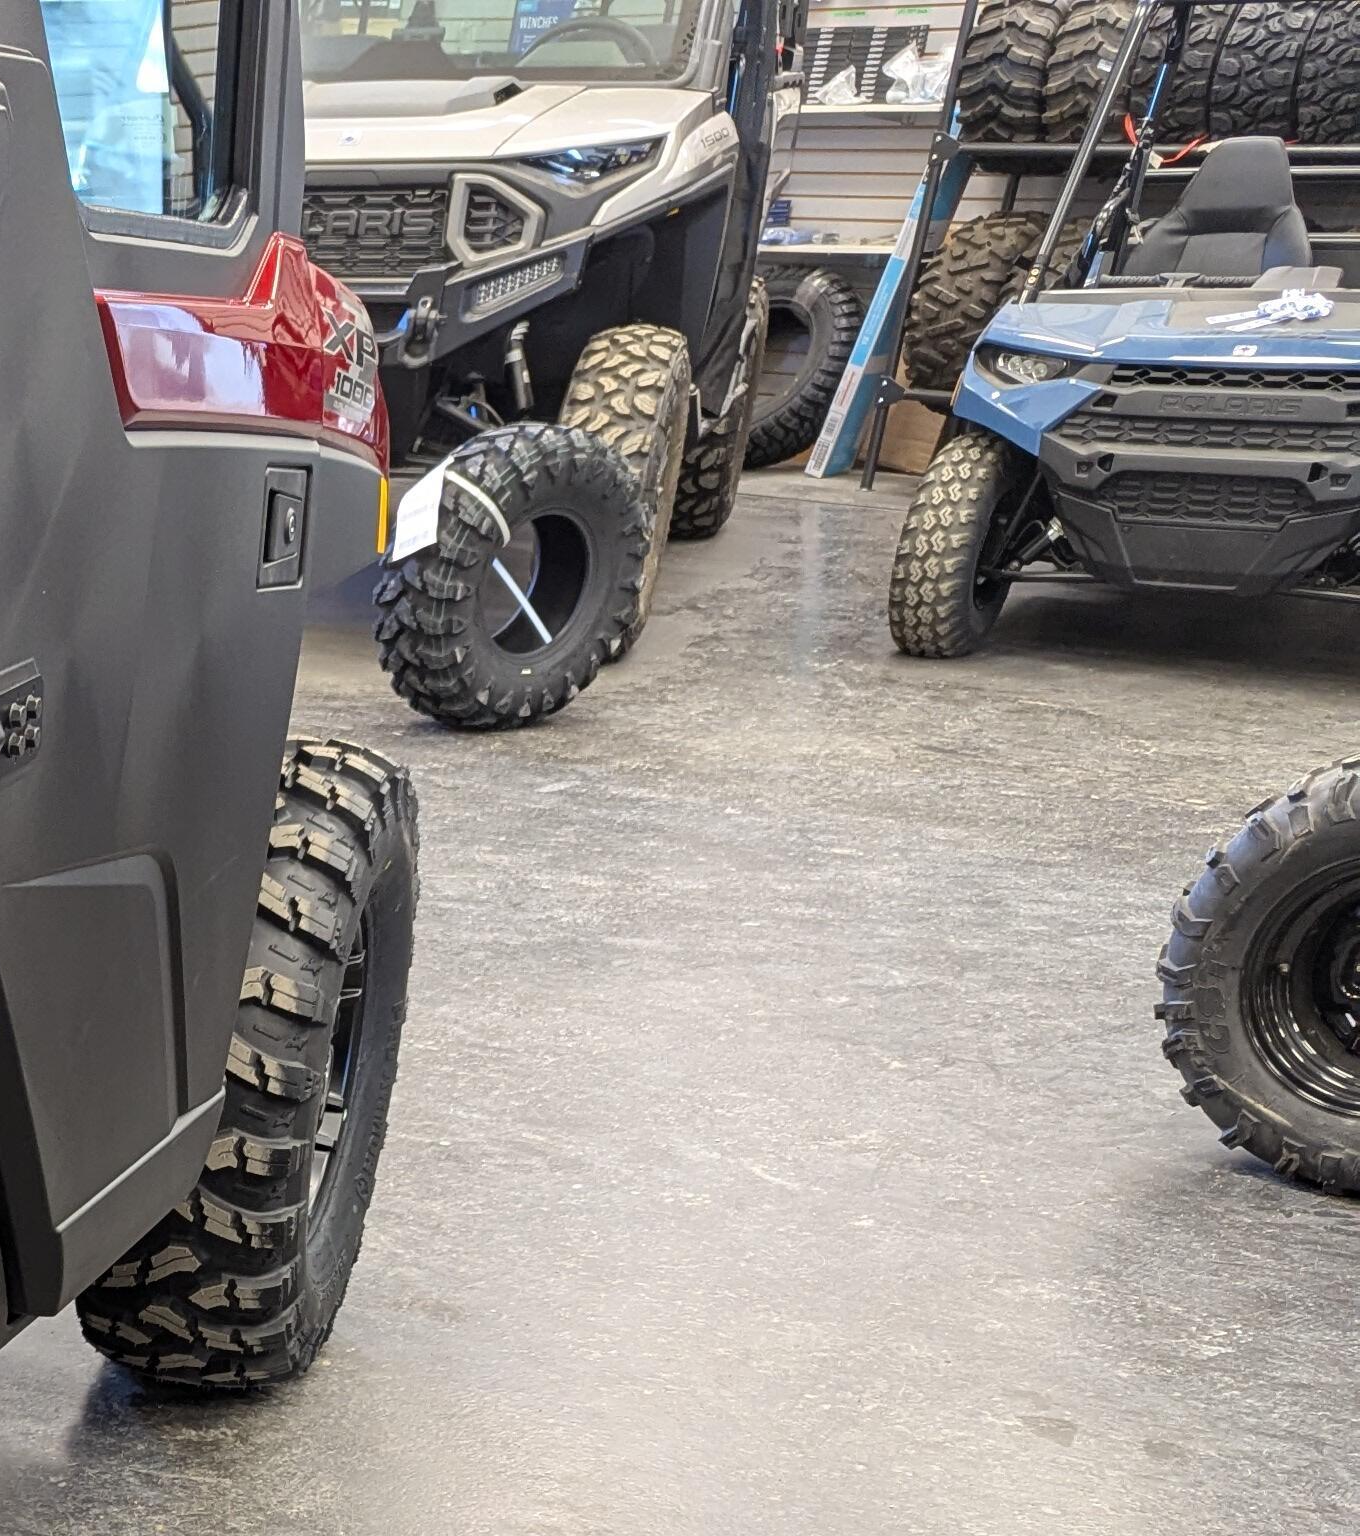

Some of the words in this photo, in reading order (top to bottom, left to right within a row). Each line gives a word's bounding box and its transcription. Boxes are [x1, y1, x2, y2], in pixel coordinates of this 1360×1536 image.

[701, 128, 730, 148] 1500
[303, 208, 435, 236] LARIS
[323, 306, 378, 369] XP
[333, 371, 375, 408] 1000
[1159, 394, 1304, 416] POLARIS
